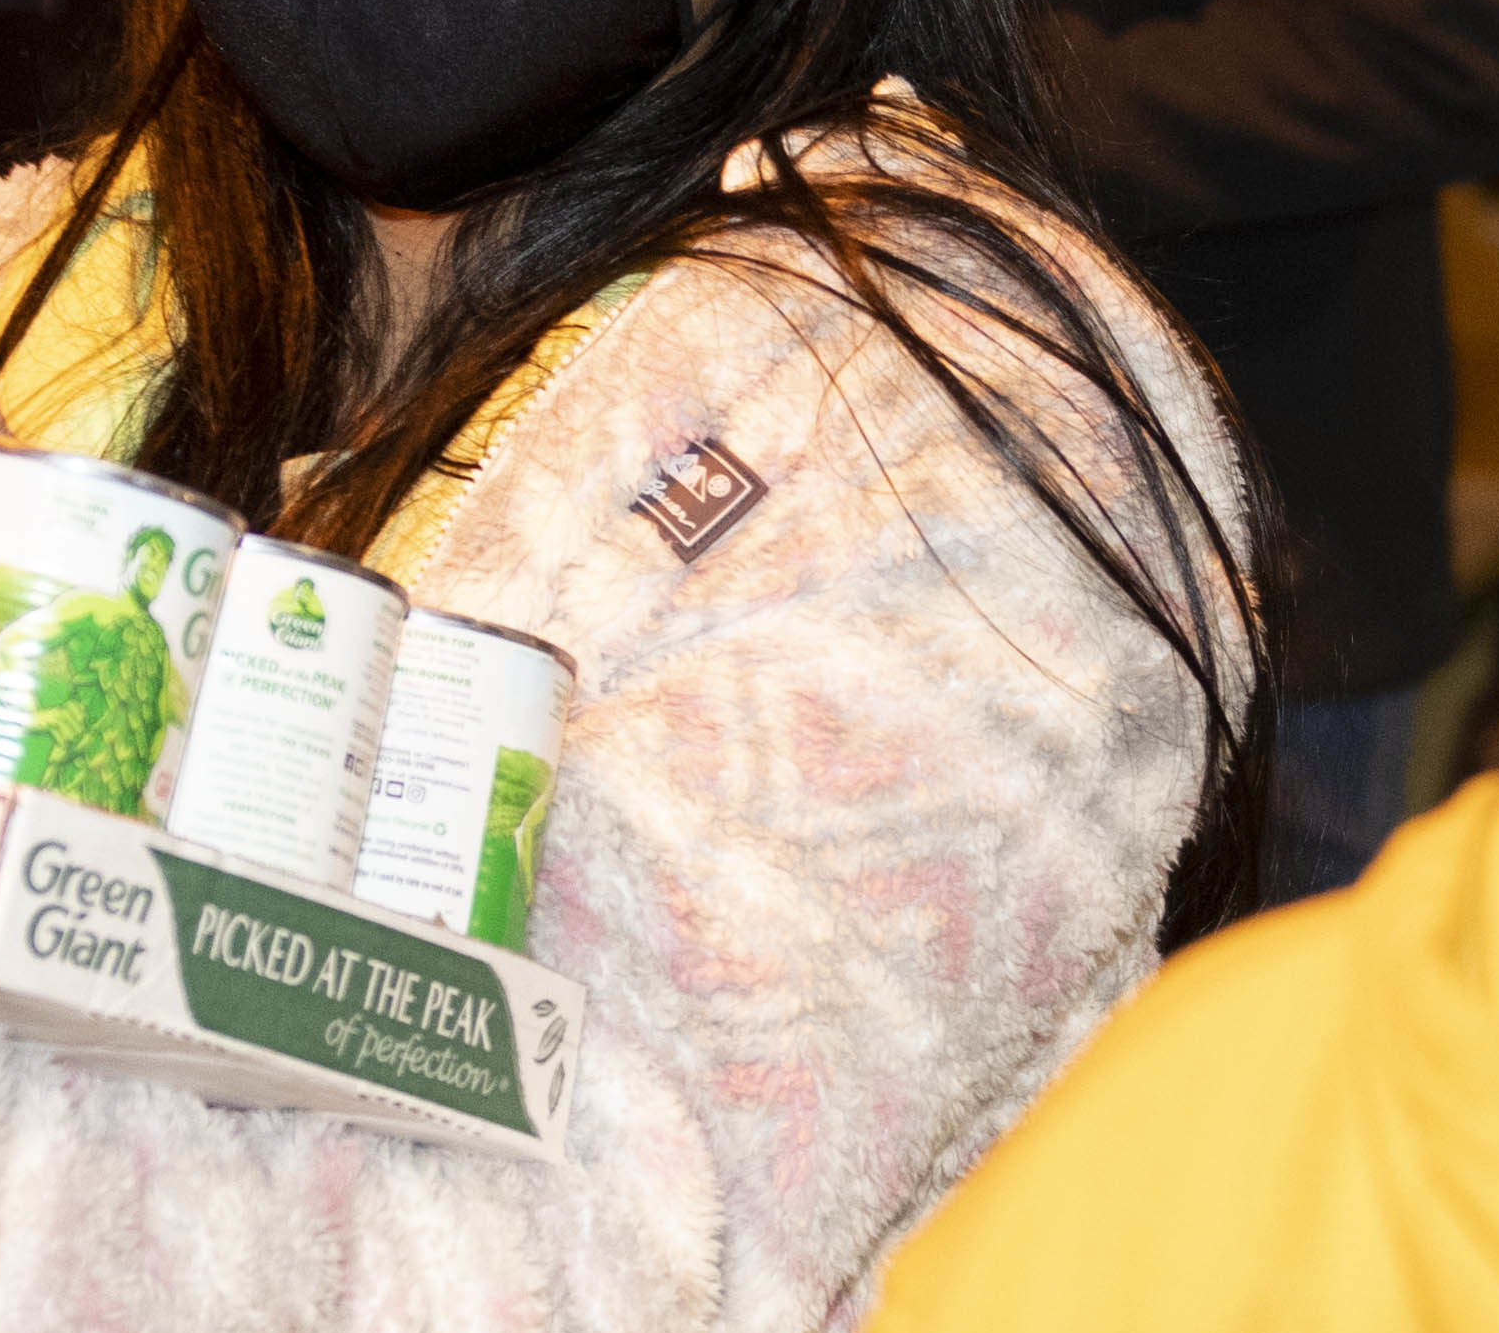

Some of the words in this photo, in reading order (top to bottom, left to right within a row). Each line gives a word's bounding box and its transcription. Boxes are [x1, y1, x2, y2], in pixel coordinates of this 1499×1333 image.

[24, 839, 154, 925] Green
[26, 903, 146, 984] Giant
[192, 903, 315, 987] PICKED
[312, 945, 364, 1002] AT
[363, 958, 422, 1025] THE
[421, 979, 497, 1053] PEAK
[325, 1013, 362, 1058] of
[354, 1023, 501, 1095] perfection
